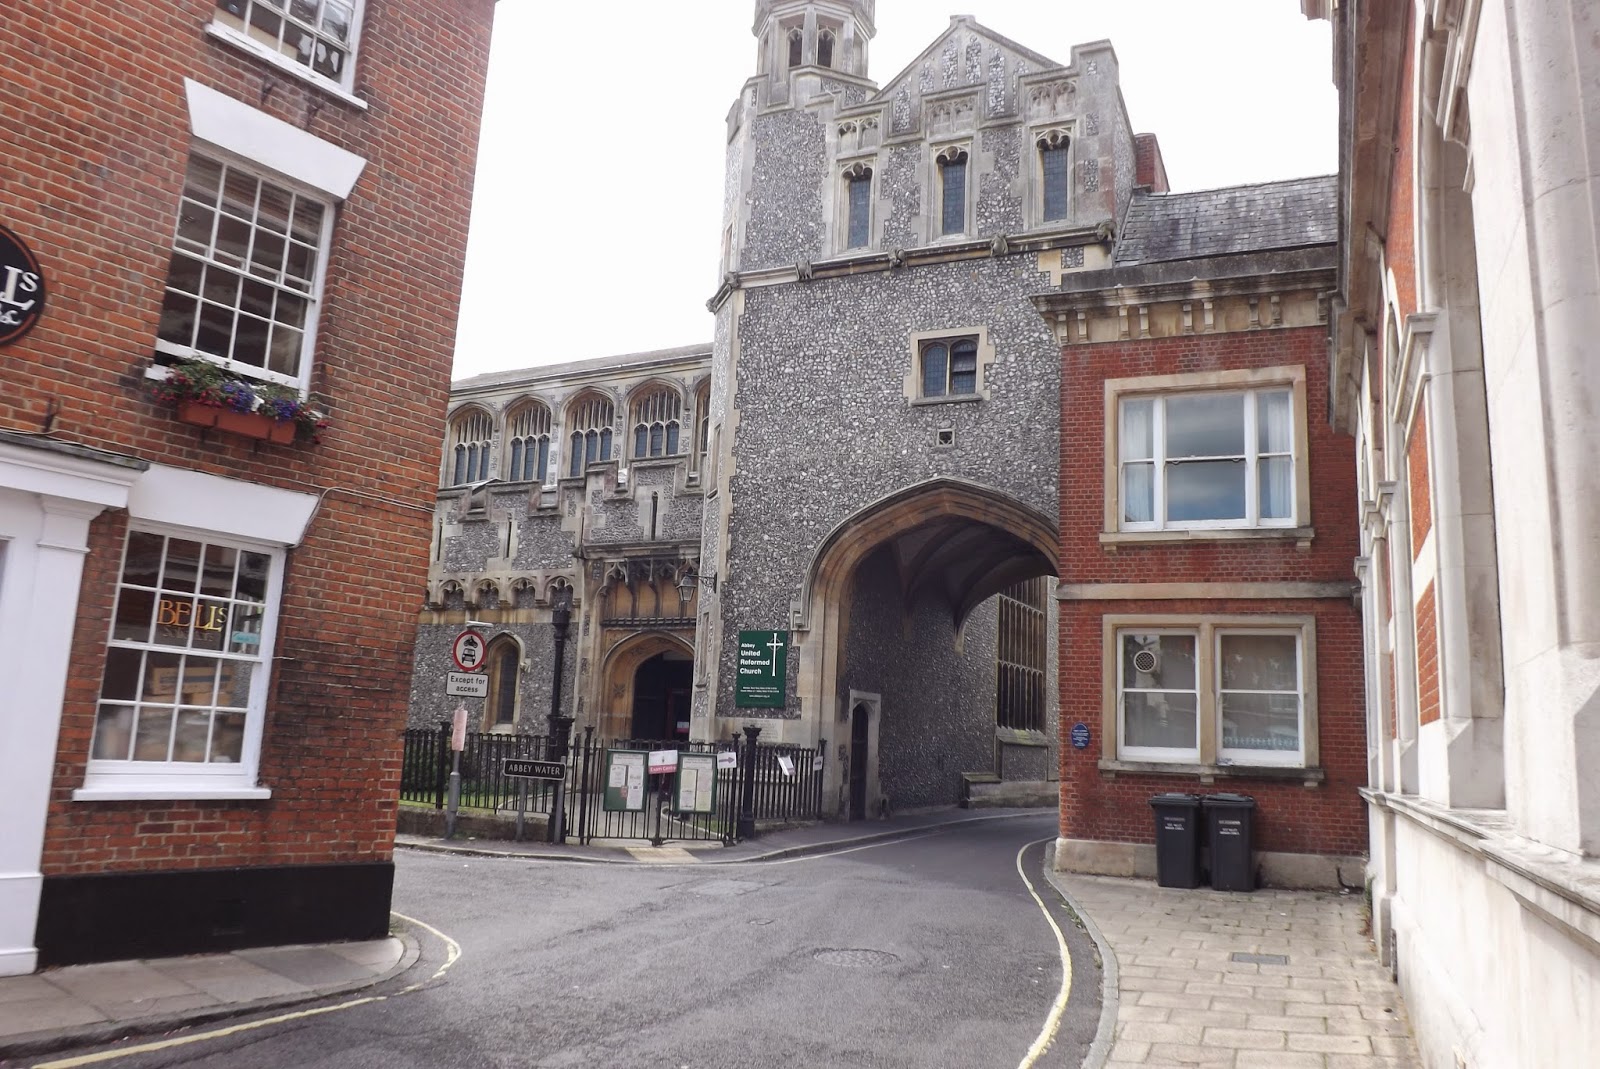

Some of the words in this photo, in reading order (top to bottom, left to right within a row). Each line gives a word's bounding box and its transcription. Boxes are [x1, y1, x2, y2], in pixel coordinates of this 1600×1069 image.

[450, 675, 474, 685] Except
[475, 677, 486, 685] for
[508, 763, 533, 773] ABBEY
[534, 765, 561, 775] WATER
